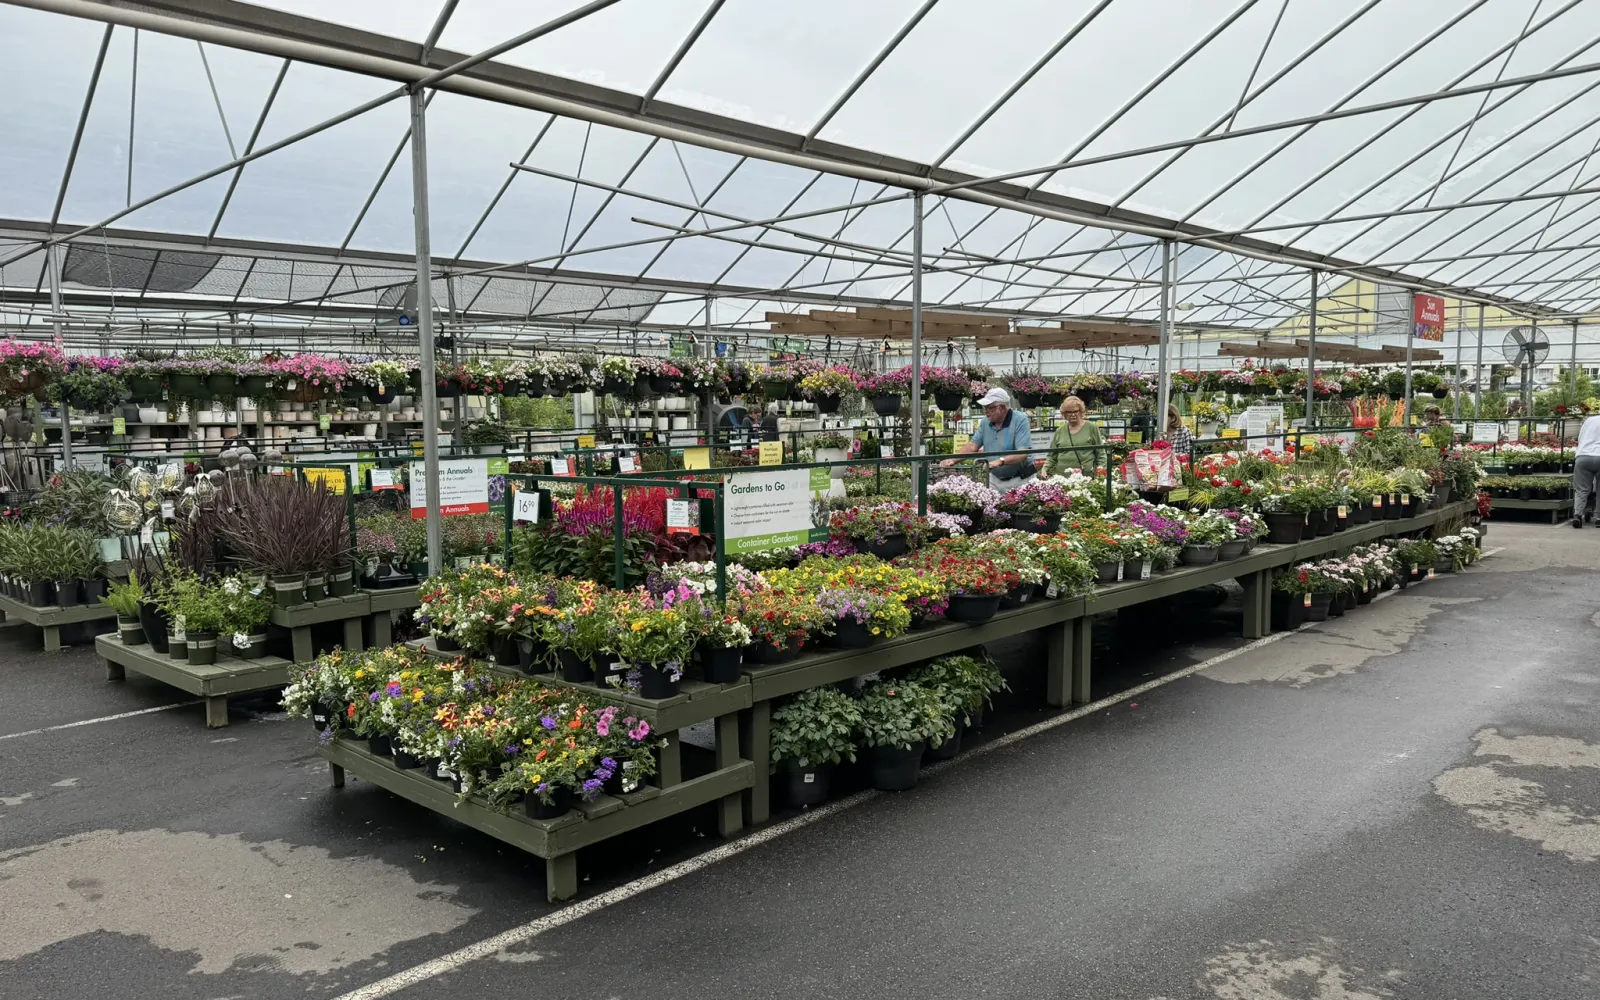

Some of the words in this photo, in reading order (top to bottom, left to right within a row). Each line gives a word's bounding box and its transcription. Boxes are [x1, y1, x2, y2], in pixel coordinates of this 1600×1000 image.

[1427, 298, 1436, 310] Sun
[1421, 308, 1440, 322] Annuals
[447, 466, 473, 474] Annuals
[731, 483, 763, 494] Gardens
[765, 484, 773, 492] to
[774, 482, 785, 491] Go
[445, 505, 470, 513] Annuals
[737, 537, 770, 548] Container
[771, 533, 799, 544] Gardens
